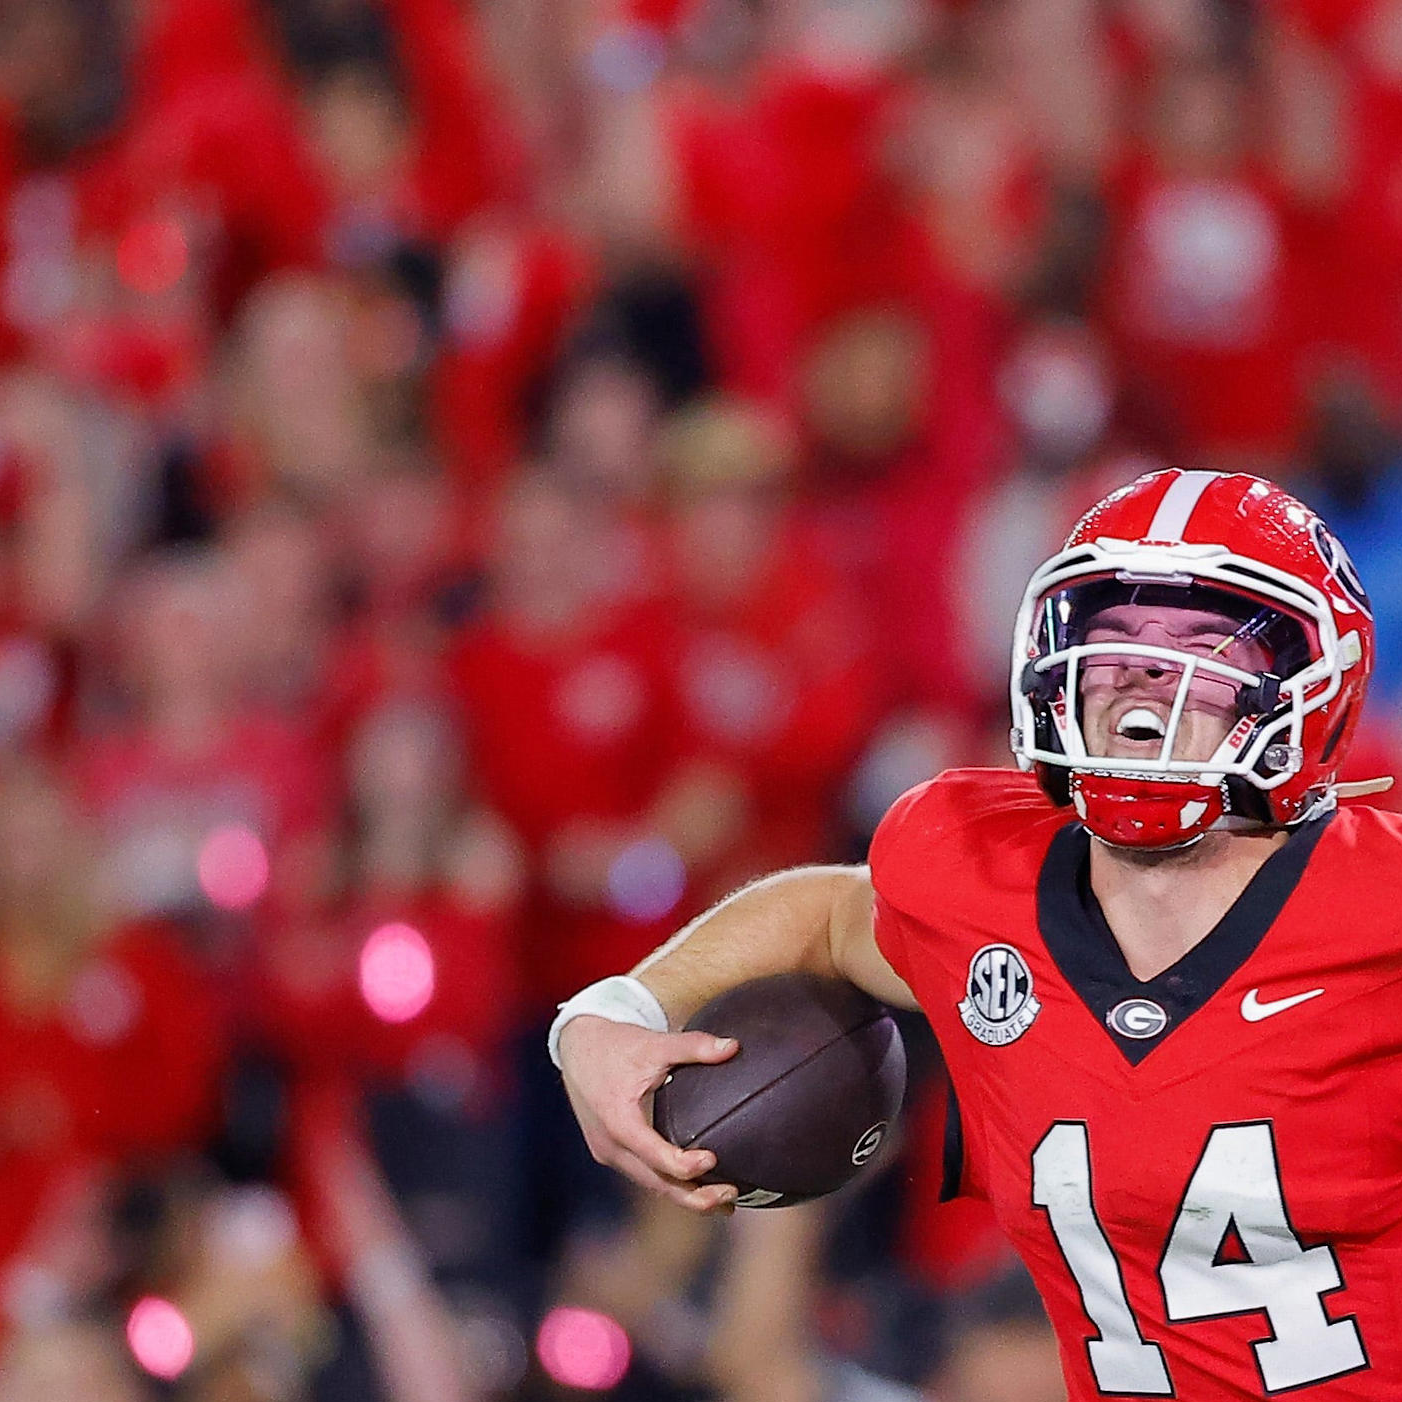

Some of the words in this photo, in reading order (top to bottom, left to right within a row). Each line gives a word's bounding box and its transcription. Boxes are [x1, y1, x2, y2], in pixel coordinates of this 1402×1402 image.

[973, 949, 1027, 1020] SEC
[965, 1014, 1028, 1044] GRADUATE
[1113, 1000, 1164, 1037] G
[1030, 1118, 1371, 1398] 14
